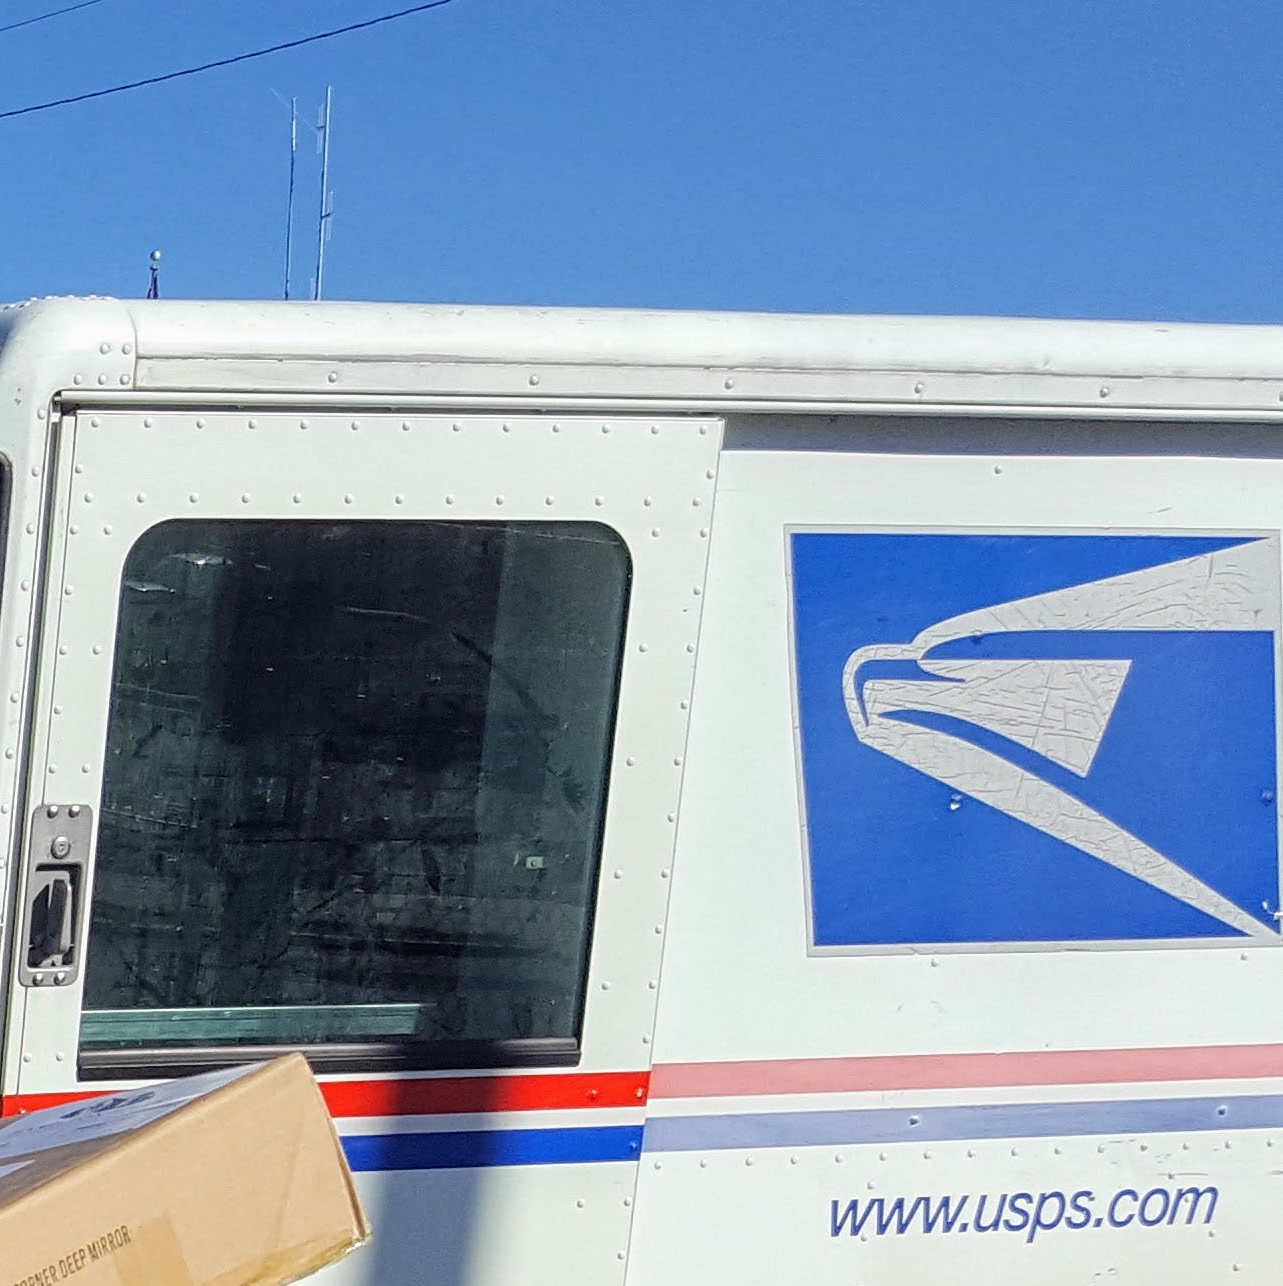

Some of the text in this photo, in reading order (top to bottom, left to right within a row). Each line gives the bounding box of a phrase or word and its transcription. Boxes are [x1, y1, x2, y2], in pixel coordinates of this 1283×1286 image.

[829, 1185, 1219, 1244] www.usps.com
[58, 1248, 87, 1280] DEEP
[87, 1224, 132, 1263] MIRROR
